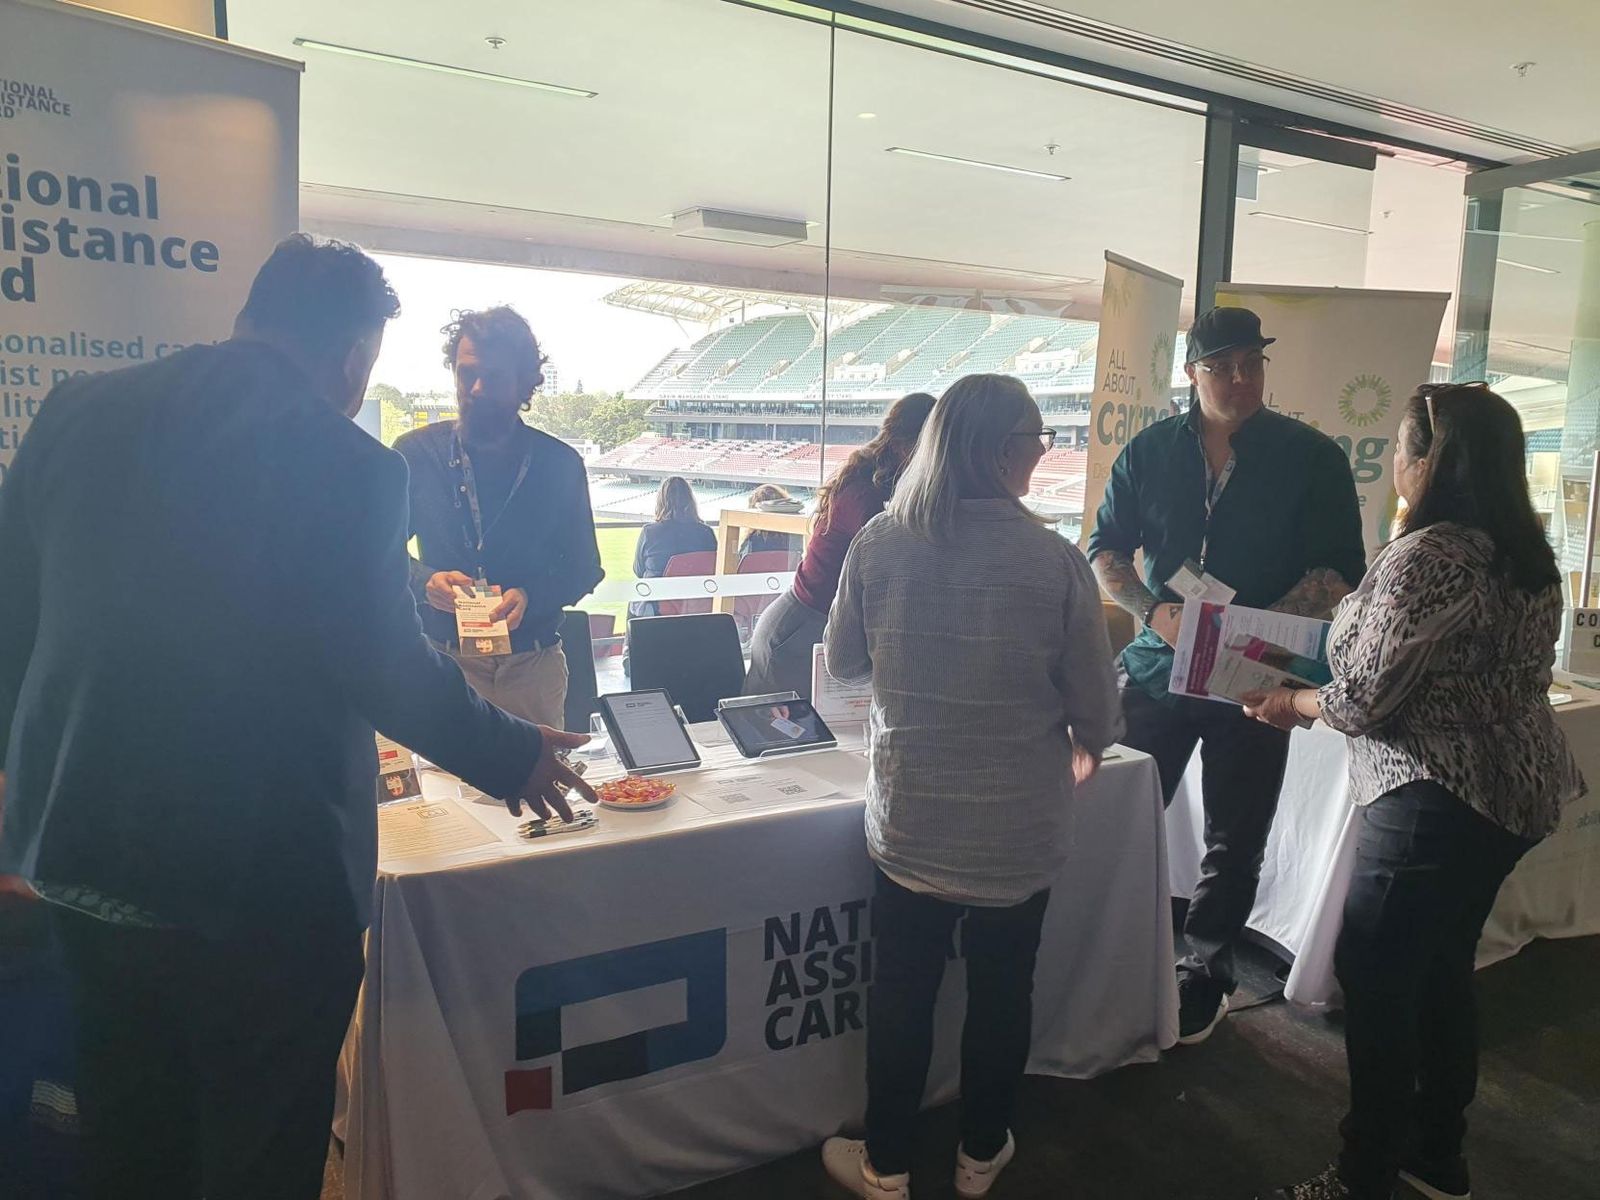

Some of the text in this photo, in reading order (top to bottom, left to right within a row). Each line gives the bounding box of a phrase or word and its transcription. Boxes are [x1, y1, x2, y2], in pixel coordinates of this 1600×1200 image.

[0, 153, 159, 220] ional
[1, 203, 220, 272] istance
[1108, 349, 1127, 371] ALL
[1102, 373, 1136, 396] ABOUT
